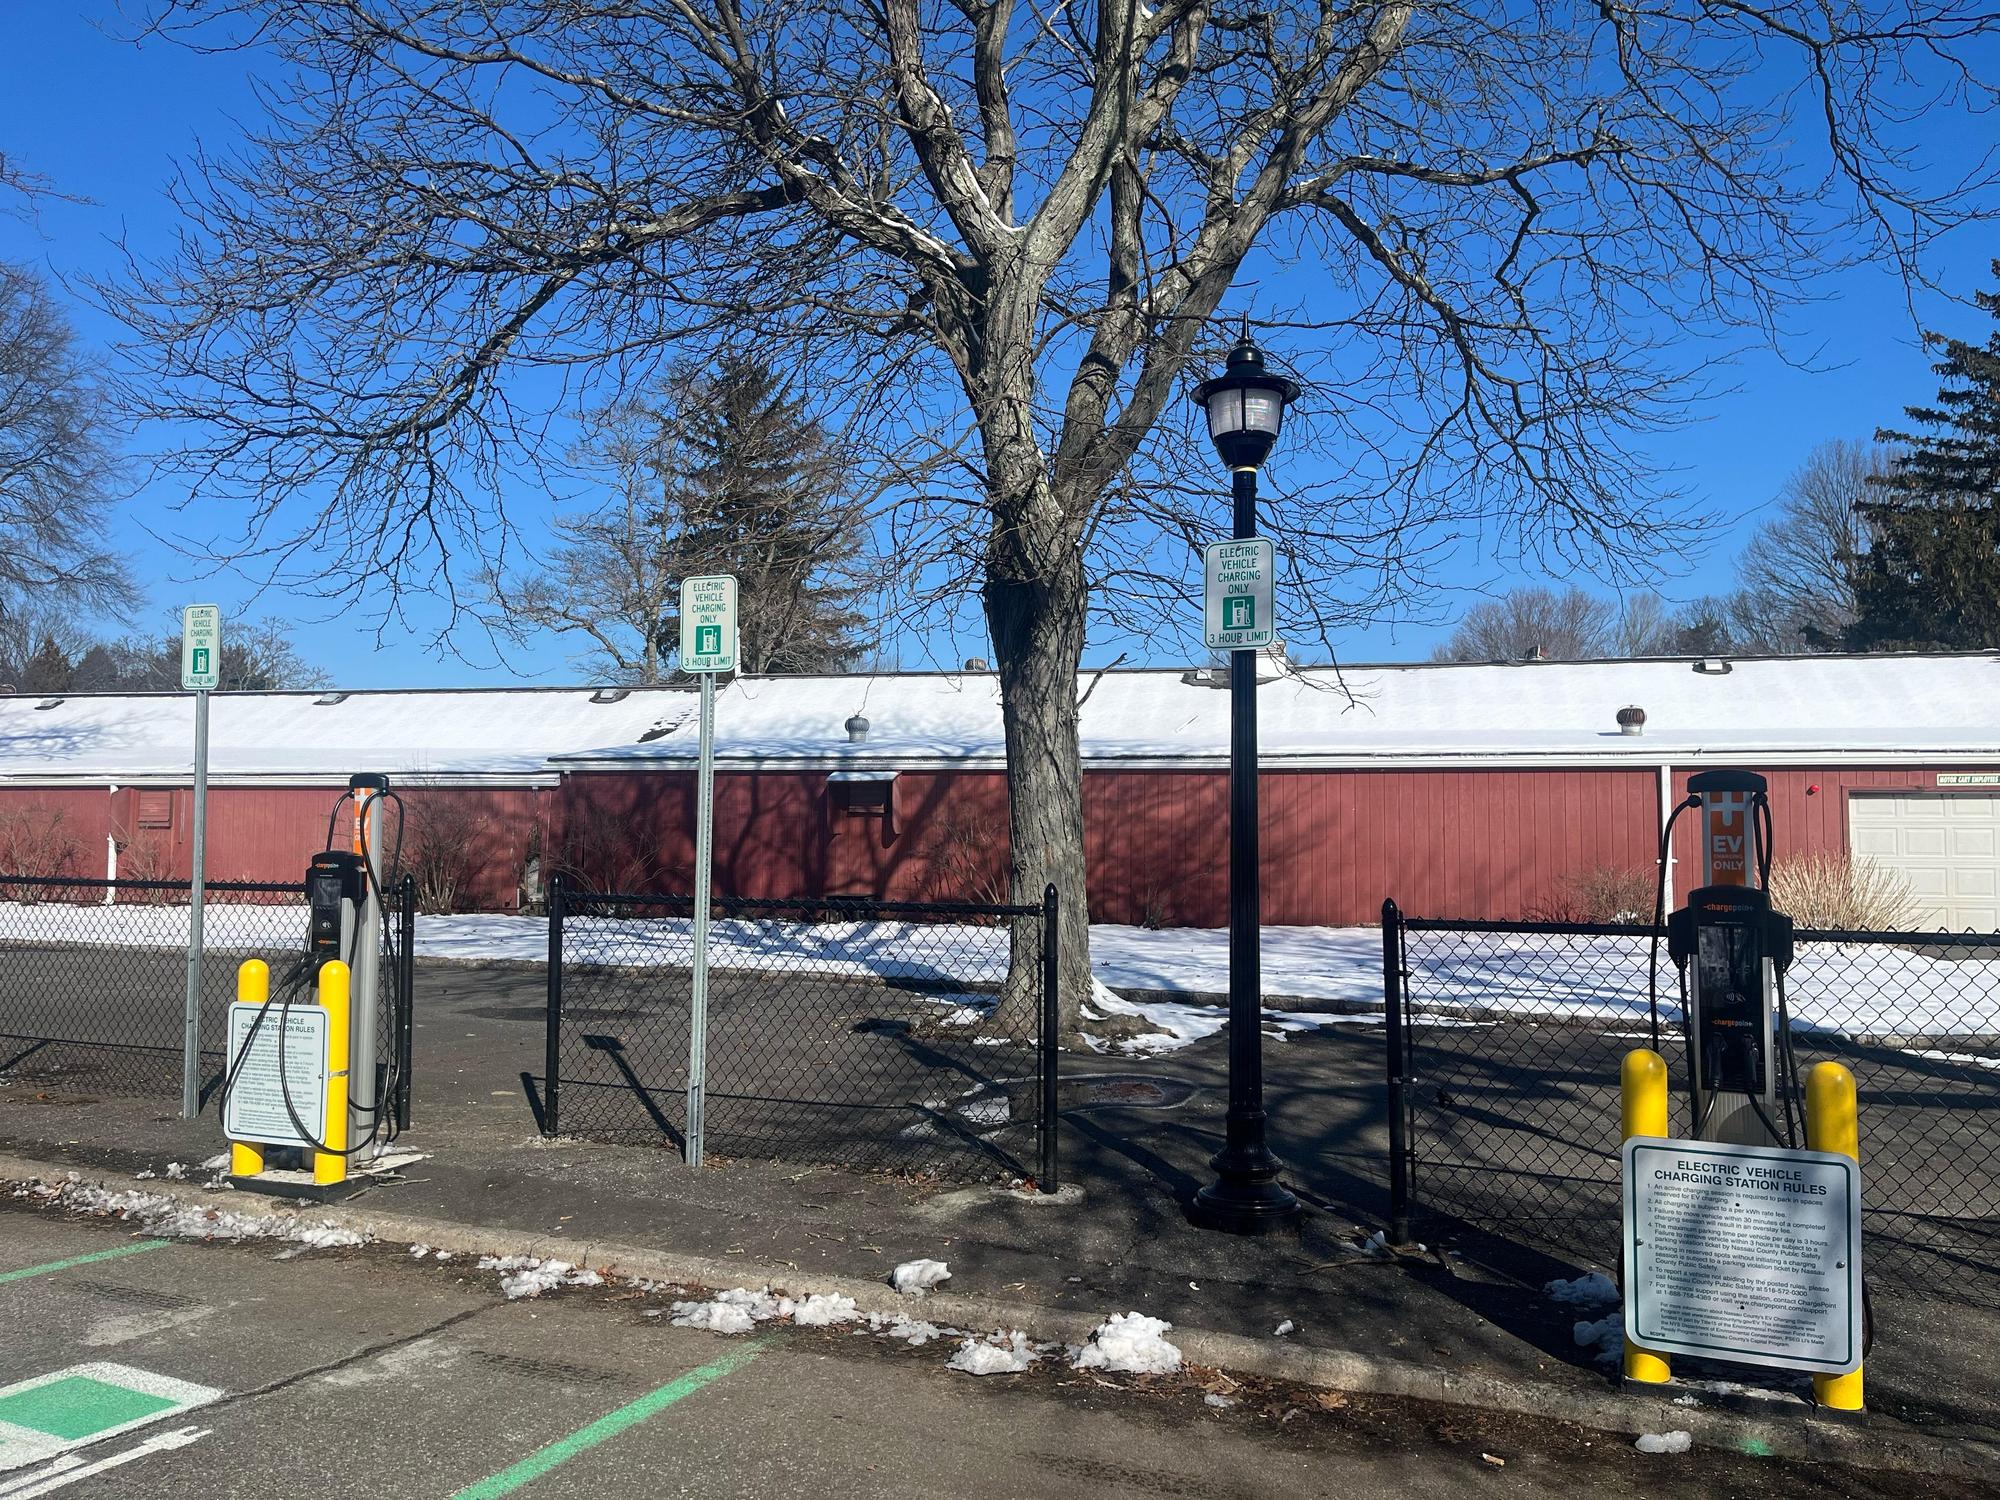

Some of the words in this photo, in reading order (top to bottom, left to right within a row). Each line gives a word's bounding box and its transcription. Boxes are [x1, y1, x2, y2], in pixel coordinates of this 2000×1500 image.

[1220, 546, 1259, 558] ELECTRIC
[1222, 558, 1256, 570] VEHICLE
[1218, 570, 1260, 582] CHARGING
[693, 582, 725, 592] ELECTRIC
[1228, 584, 1249, 594] ONLY
[695, 592, 723, 602] VEHICLE
[692, 603, 726, 613] CHARGING
[192, 610, 212, 618] ELECTRIC
[700, 615, 717, 623] ONLY
[193, 619, 211, 627] VEHICLE
[191, 628, 212, 637] CHARGING
[1210, 634, 1215, 643] 3
[1219, 632, 1242, 643] HOUR
[1247, 631, 1268, 641] LIMIT
[685, 658, 689, 667] 3
[692, 657, 711, 666] HOUR
[714, 656, 731, 665] LIMIT
[204, 676, 215, 684] LIMIT
[1713, 836, 1743, 852] EV
[1714, 860, 1744, 870] ONLY
[1677, 1160, 1739, 1175] ELECTRIC
[1746, 1166, 1801, 1181] VEHICLE
[1654, 1170, 1721, 1185] CHARGING
[1725, 1176, 1778, 1190] STATION
[1783, 1182, 1826, 1195] RULES
[1682, 1186, 1709, 1195] charging
[1742, 1192, 1768, 1201] required
[1663, 1200, 1689, 1209] charging
[1654, 1214, 1680, 1223] charging
[1792, 1221, 1825, 1231] completed
[1654, 1236, 1677, 1244] parking
[1756, 1247, 1778, 1256] County
[1781, 1243, 1804, 1251] subject
[1655, 1258, 1676, 1266] County
[1713, 1251, 1730, 1259] spots
[1788, 1259, 1815, 1268] charging
[1691, 1277, 1713, 1286] County
[1722, 1274, 1745, 1283] abiding
[1766, 1279, 1788, 1288] posted
